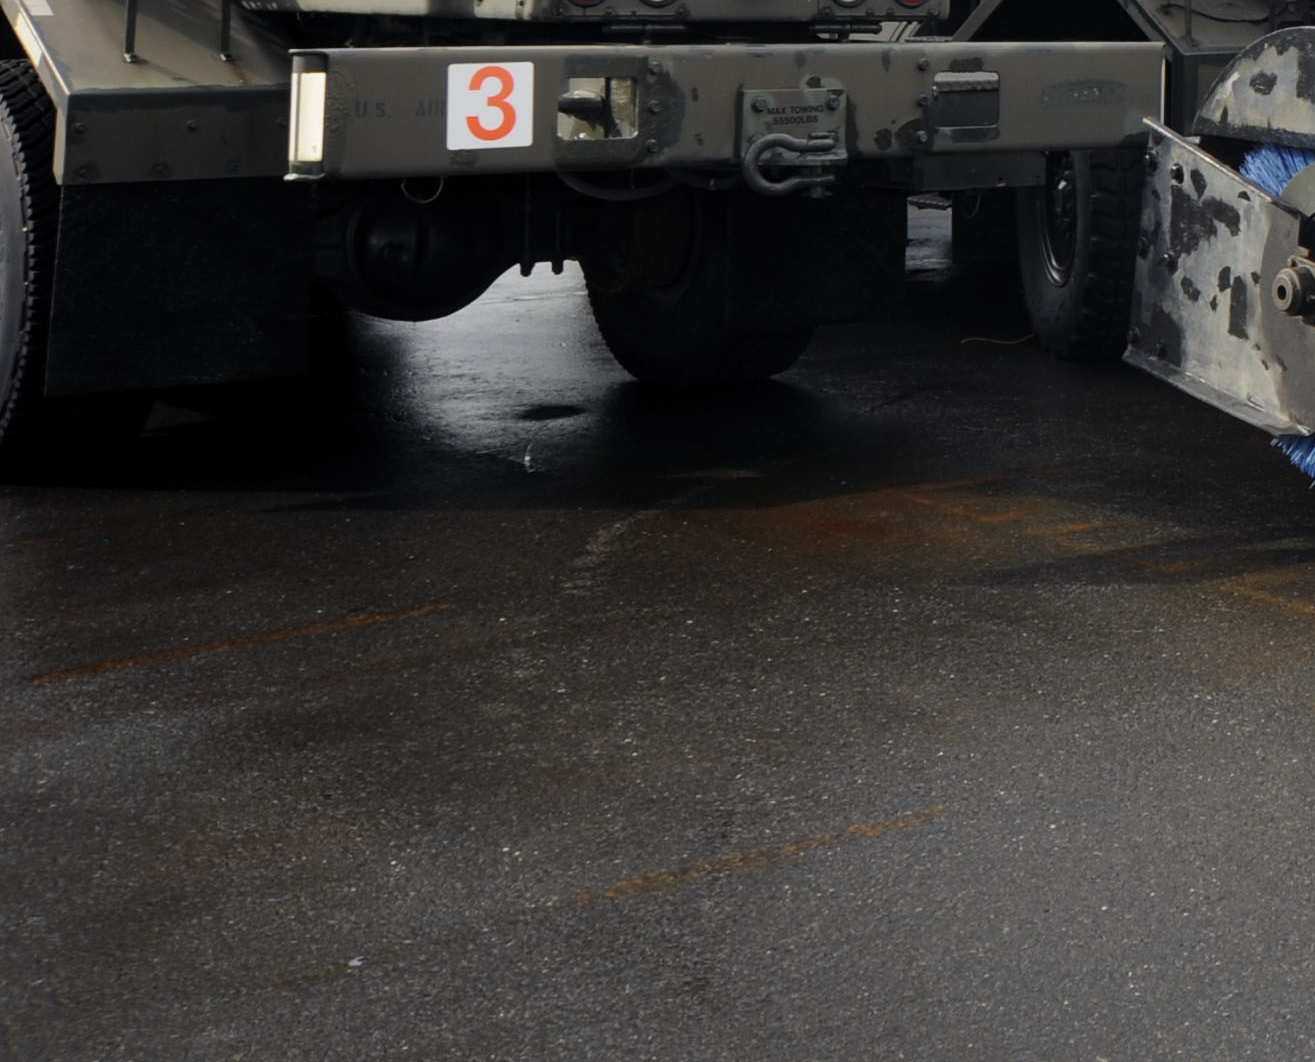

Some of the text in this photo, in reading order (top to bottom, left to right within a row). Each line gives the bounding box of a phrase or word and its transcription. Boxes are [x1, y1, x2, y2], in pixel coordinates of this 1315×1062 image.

[354, 100, 393, 119] U.S.
[465, 66, 517, 141] 3
[766, 104, 825, 115] MAX TOWING
